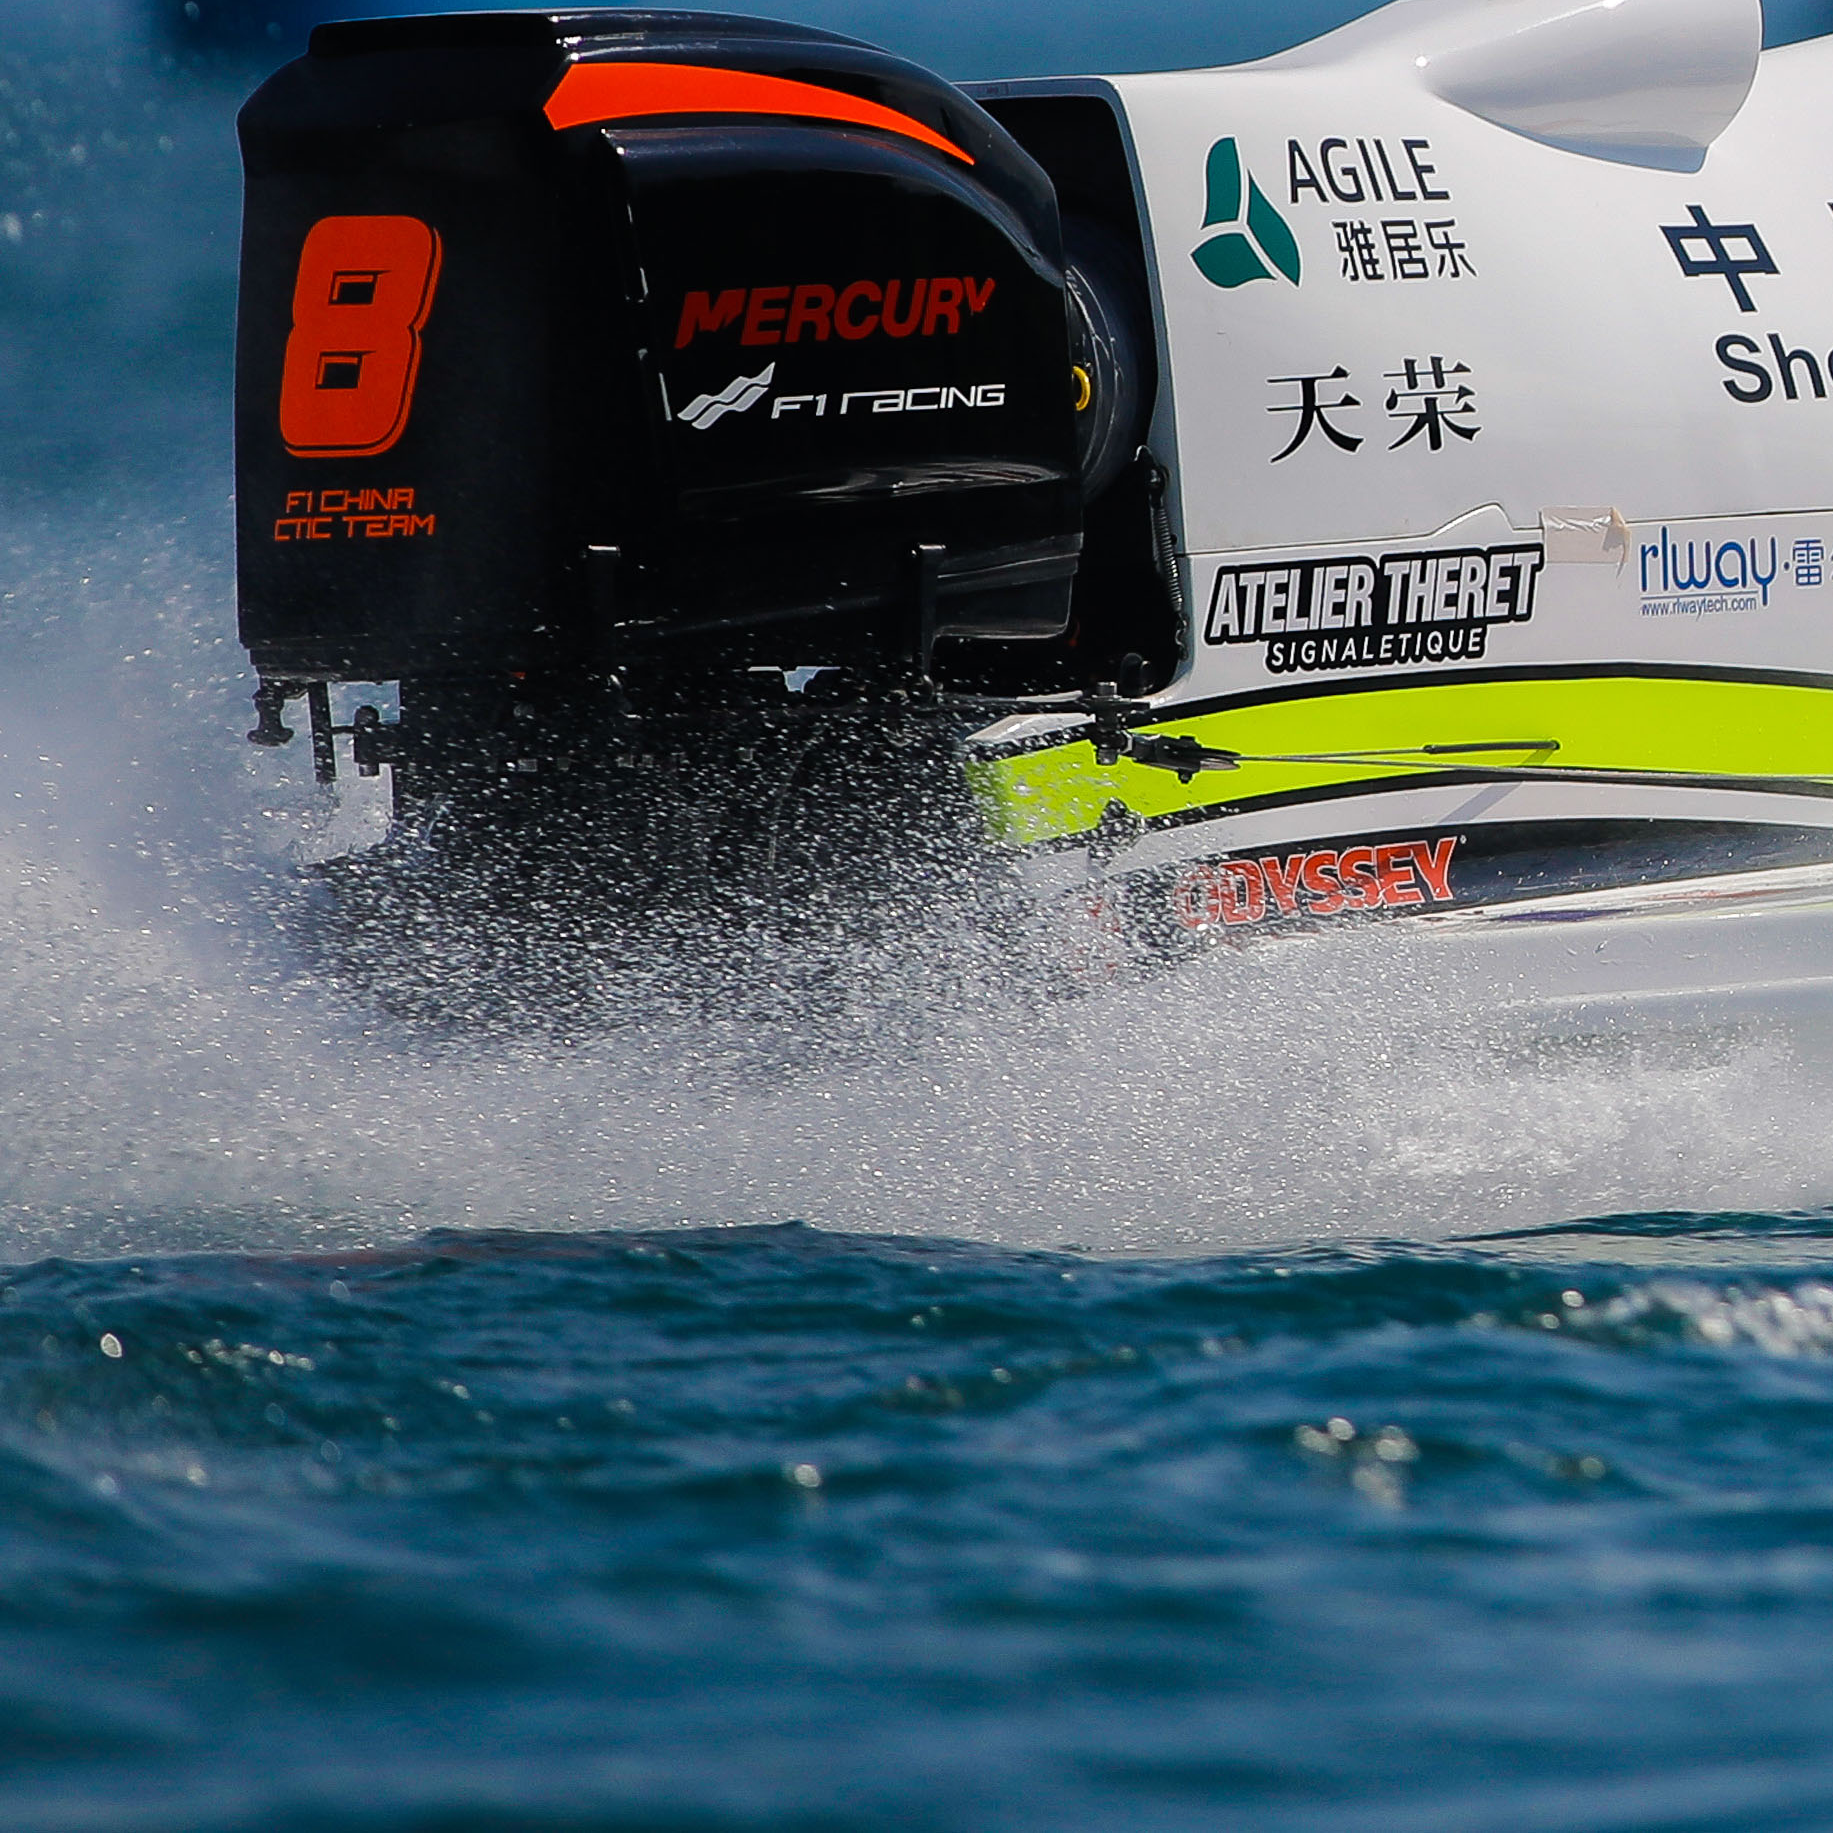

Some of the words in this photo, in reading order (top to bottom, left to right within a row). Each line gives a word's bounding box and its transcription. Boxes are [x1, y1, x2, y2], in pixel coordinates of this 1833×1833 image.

[1288, 138, 1451, 203] AGILE
[1331, 219, 1477, 282] 雅居乐
[280, 215, 443, 458] 8
[674, 276, 996, 349] MERCURY
[771, 393, 828, 419] F1
[1265, 355, 1482, 463] 天荣
[274, 516, 333, 541] CTIC
[342, 514, 436, 538] TEAM
[286, 490, 313, 513] F1
[320, 488, 415, 512] CHINA
[1209, 564, 1376, 638] ATELIER
[1383, 551, 1541, 625] THERET
[1271, 627, 1484, 666] SIGNALETIQUE
[1175, 835, 1458, 929] ODYSSEY
